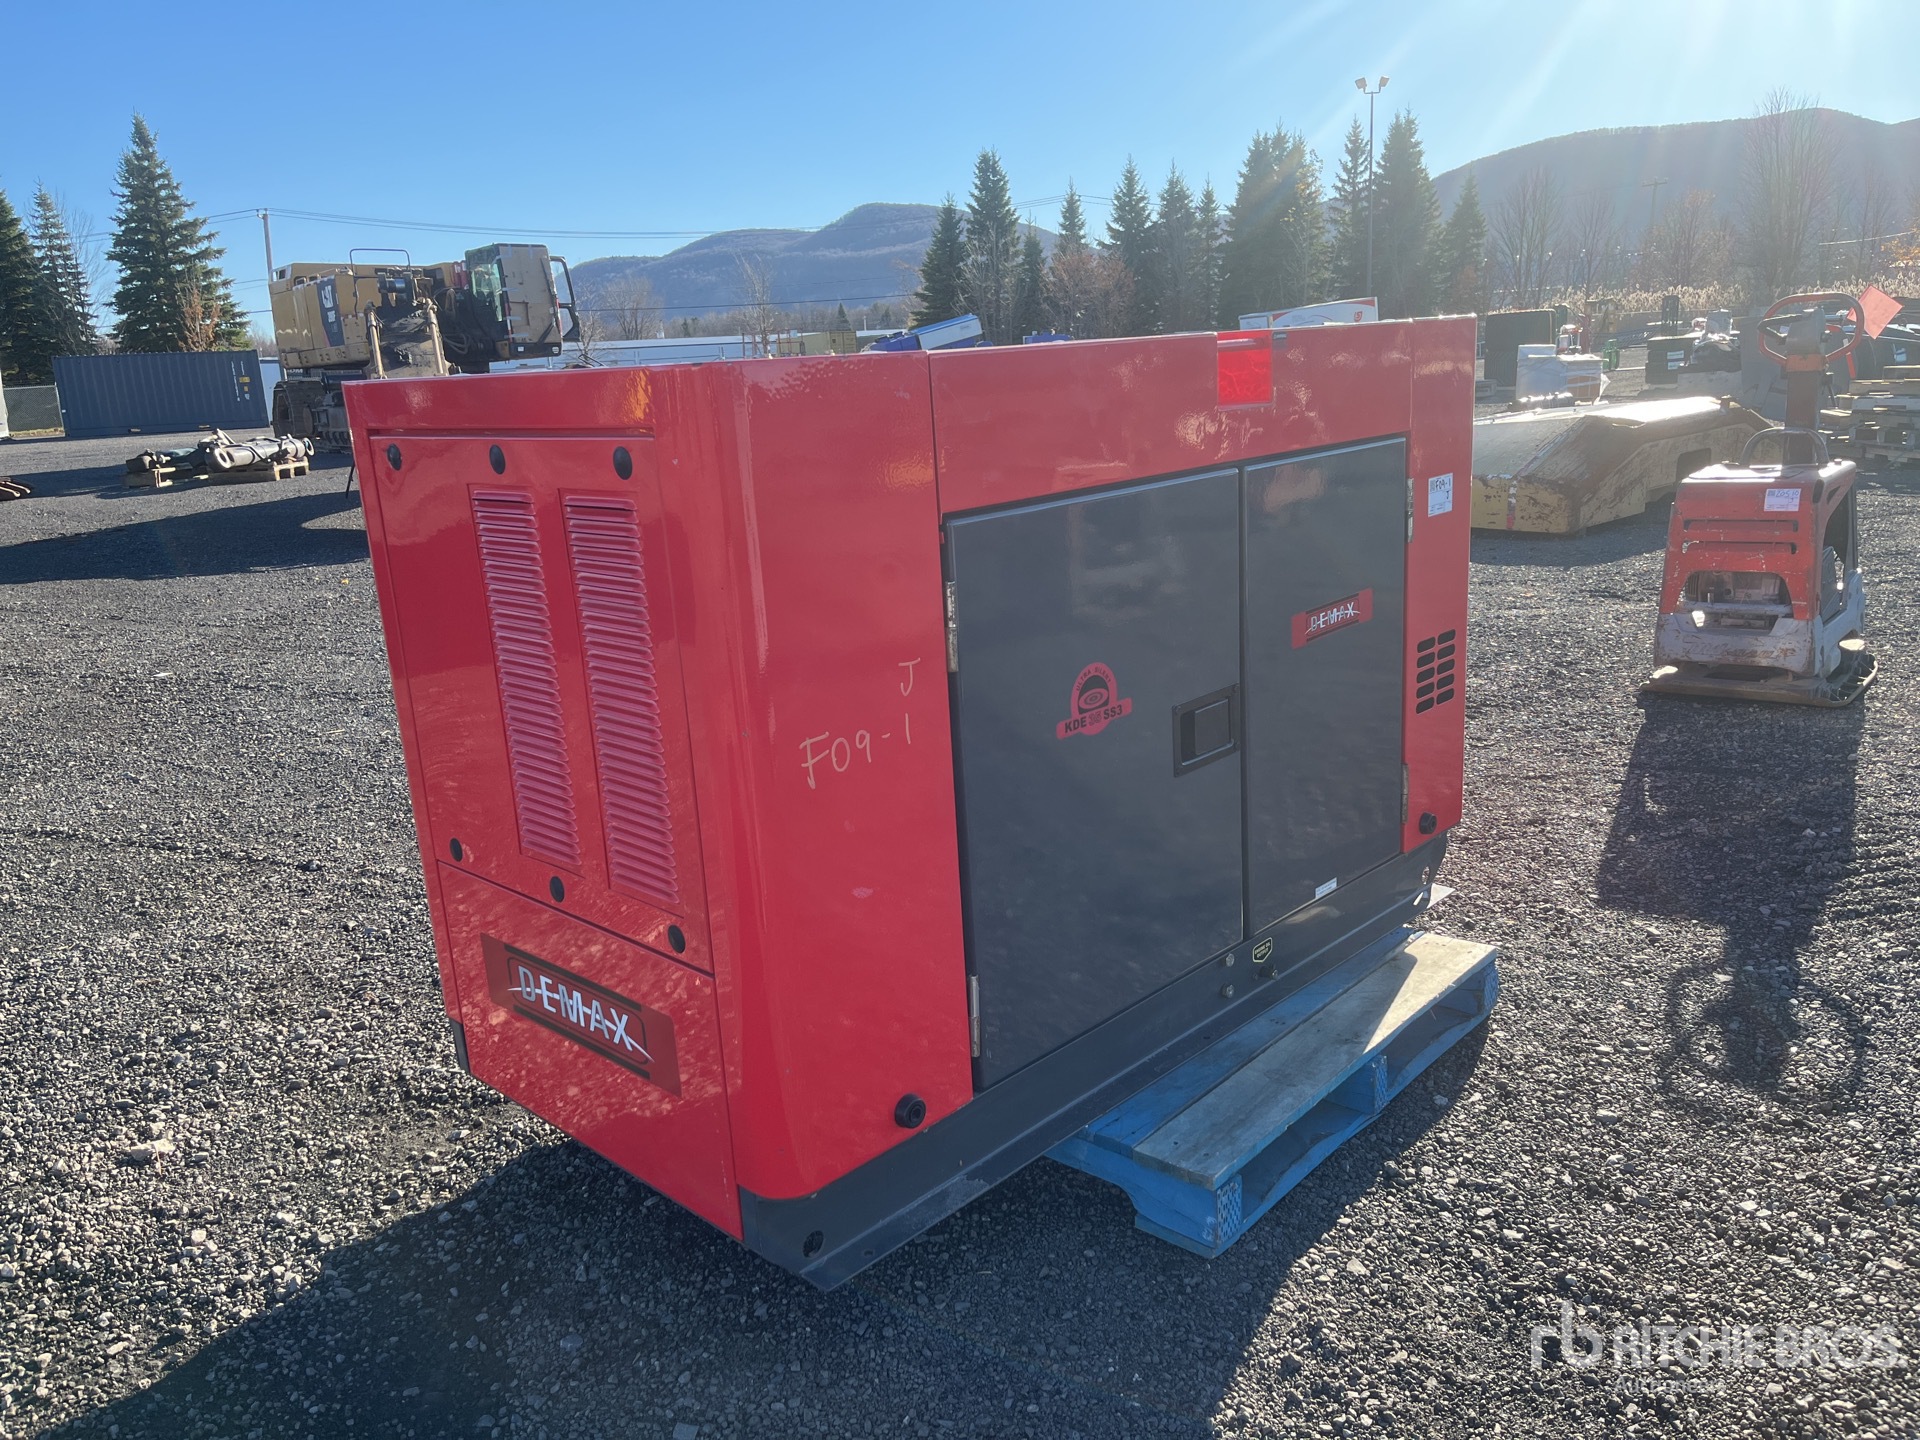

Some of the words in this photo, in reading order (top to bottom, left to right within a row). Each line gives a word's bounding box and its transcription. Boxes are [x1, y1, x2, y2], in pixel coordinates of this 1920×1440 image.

[1309, 601, 1355, 632] DEMAX
[898, 657, 921, 697] J
[1064, 716, 1087, 734] KDE
[1103, 704, 1123, 720] SS3
[799, 712, 911, 790] F09-1
[517, 964, 634, 1052] DEMAX
